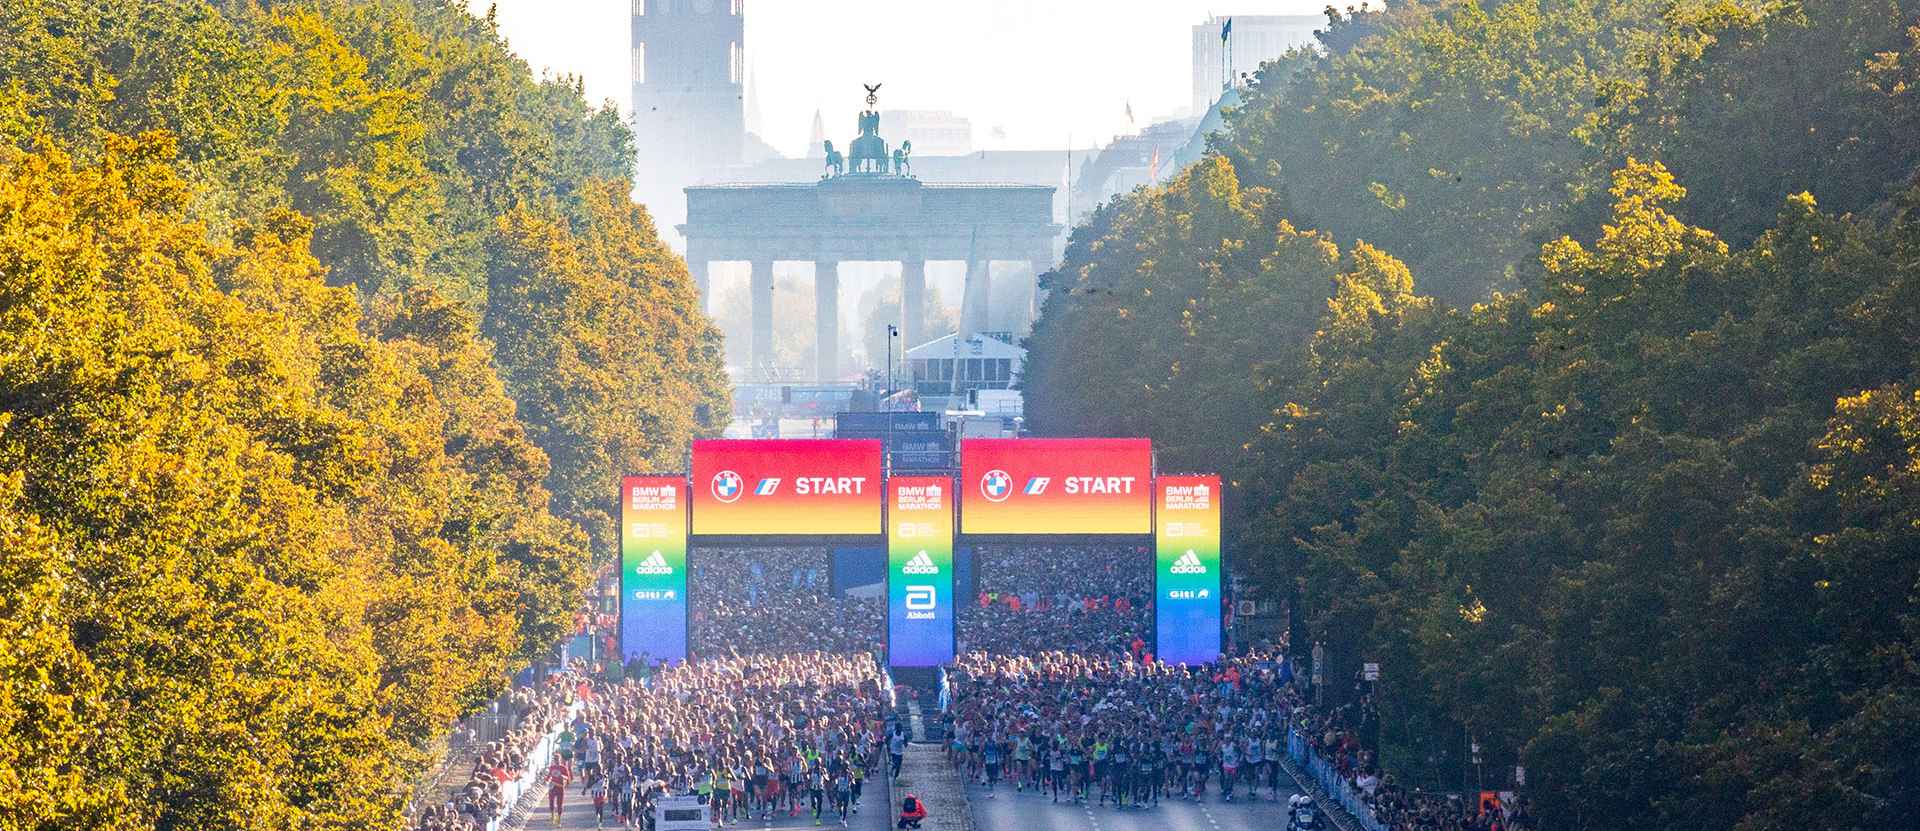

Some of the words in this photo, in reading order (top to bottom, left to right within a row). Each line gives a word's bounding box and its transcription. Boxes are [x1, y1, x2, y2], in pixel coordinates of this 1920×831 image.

[795, 477, 866, 495] START
[1065, 476, 1135, 494] START
[632, 487, 659, 497] BMW
[898, 486, 926, 496] BMW
[1166, 486, 1193, 496] BMW
[1166, 502, 1210, 510] MARATHON
[636, 566, 673, 575] adidas
[902, 566, 939, 575] adidas
[1170, 565, 1207, 574] adidas
[906, 611, 936, 620] Abbott
